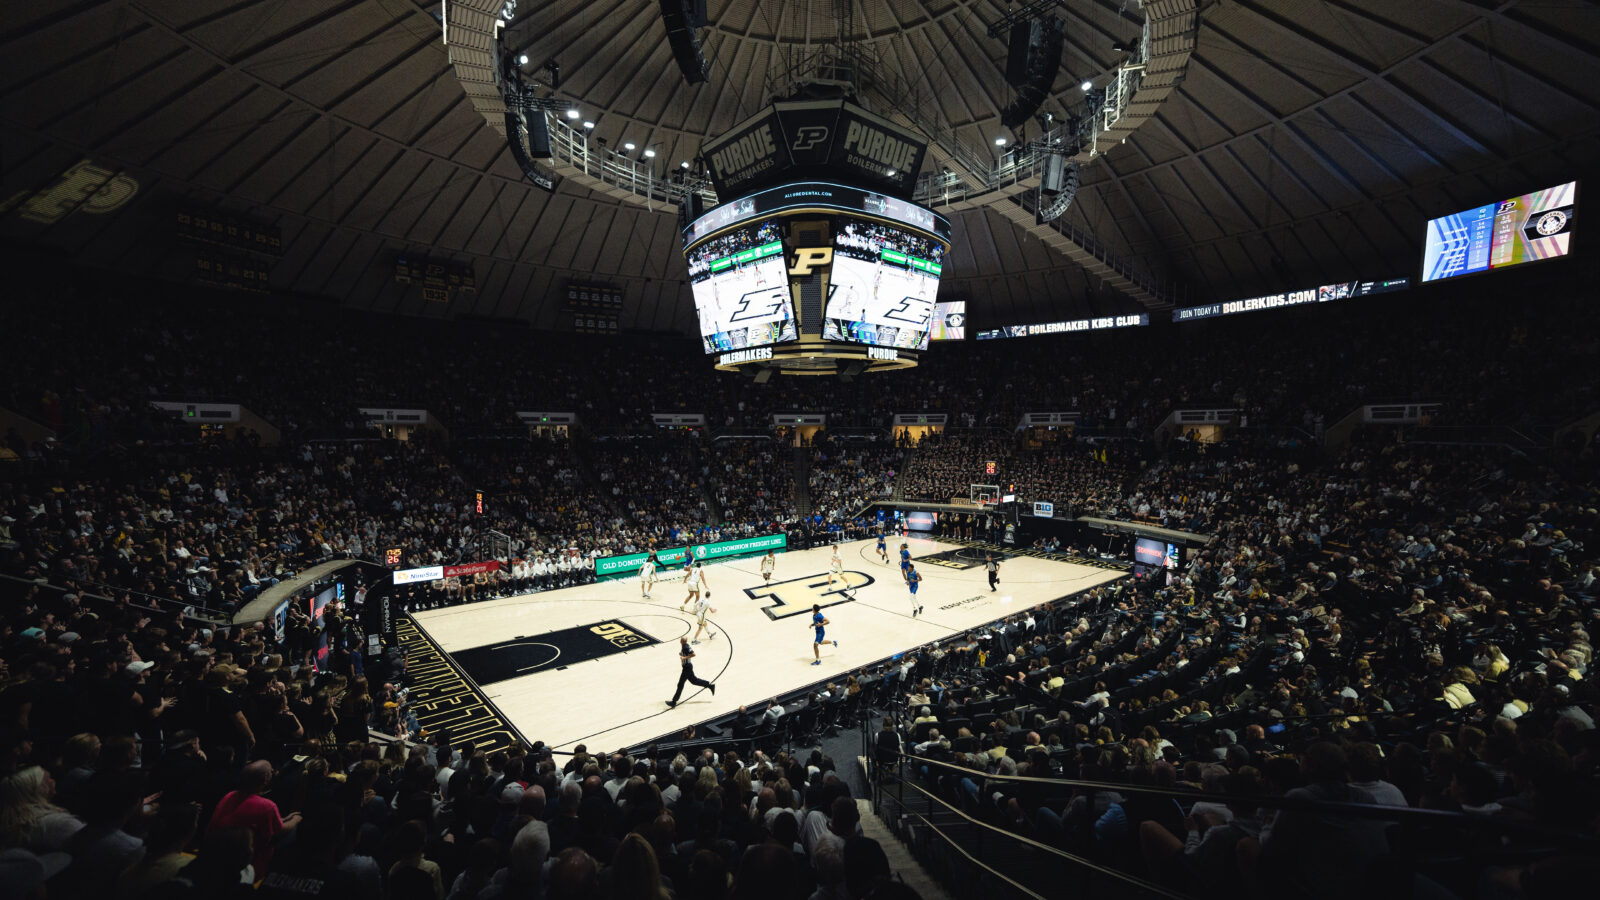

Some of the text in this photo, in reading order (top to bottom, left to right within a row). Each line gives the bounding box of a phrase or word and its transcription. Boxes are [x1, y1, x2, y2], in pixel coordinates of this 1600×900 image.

[792, 126, 829, 150] P
[843, 120, 918, 174] PURDUE
[711, 123, 777, 181] PURDUE
[847, 154, 905, 182] BOILERMAERS
[788, 247, 833, 276] P
[1180, 290, 1317, 319] JOIN TODAY AT BOILERKIDS.COM
[1029, 315, 1141, 335] BOILERMAKER KIDS CLUB
[868, 347, 898, 360] PURDUE
[387, 556, 400, 564] 26
[722, 543, 749, 553] DOMINION
[602, 561, 617, 570] OLD
[657, 552, 677, 561] EIGHT
[410, 571, 439, 580] NineStar
[742, 570, 876, 622] P
